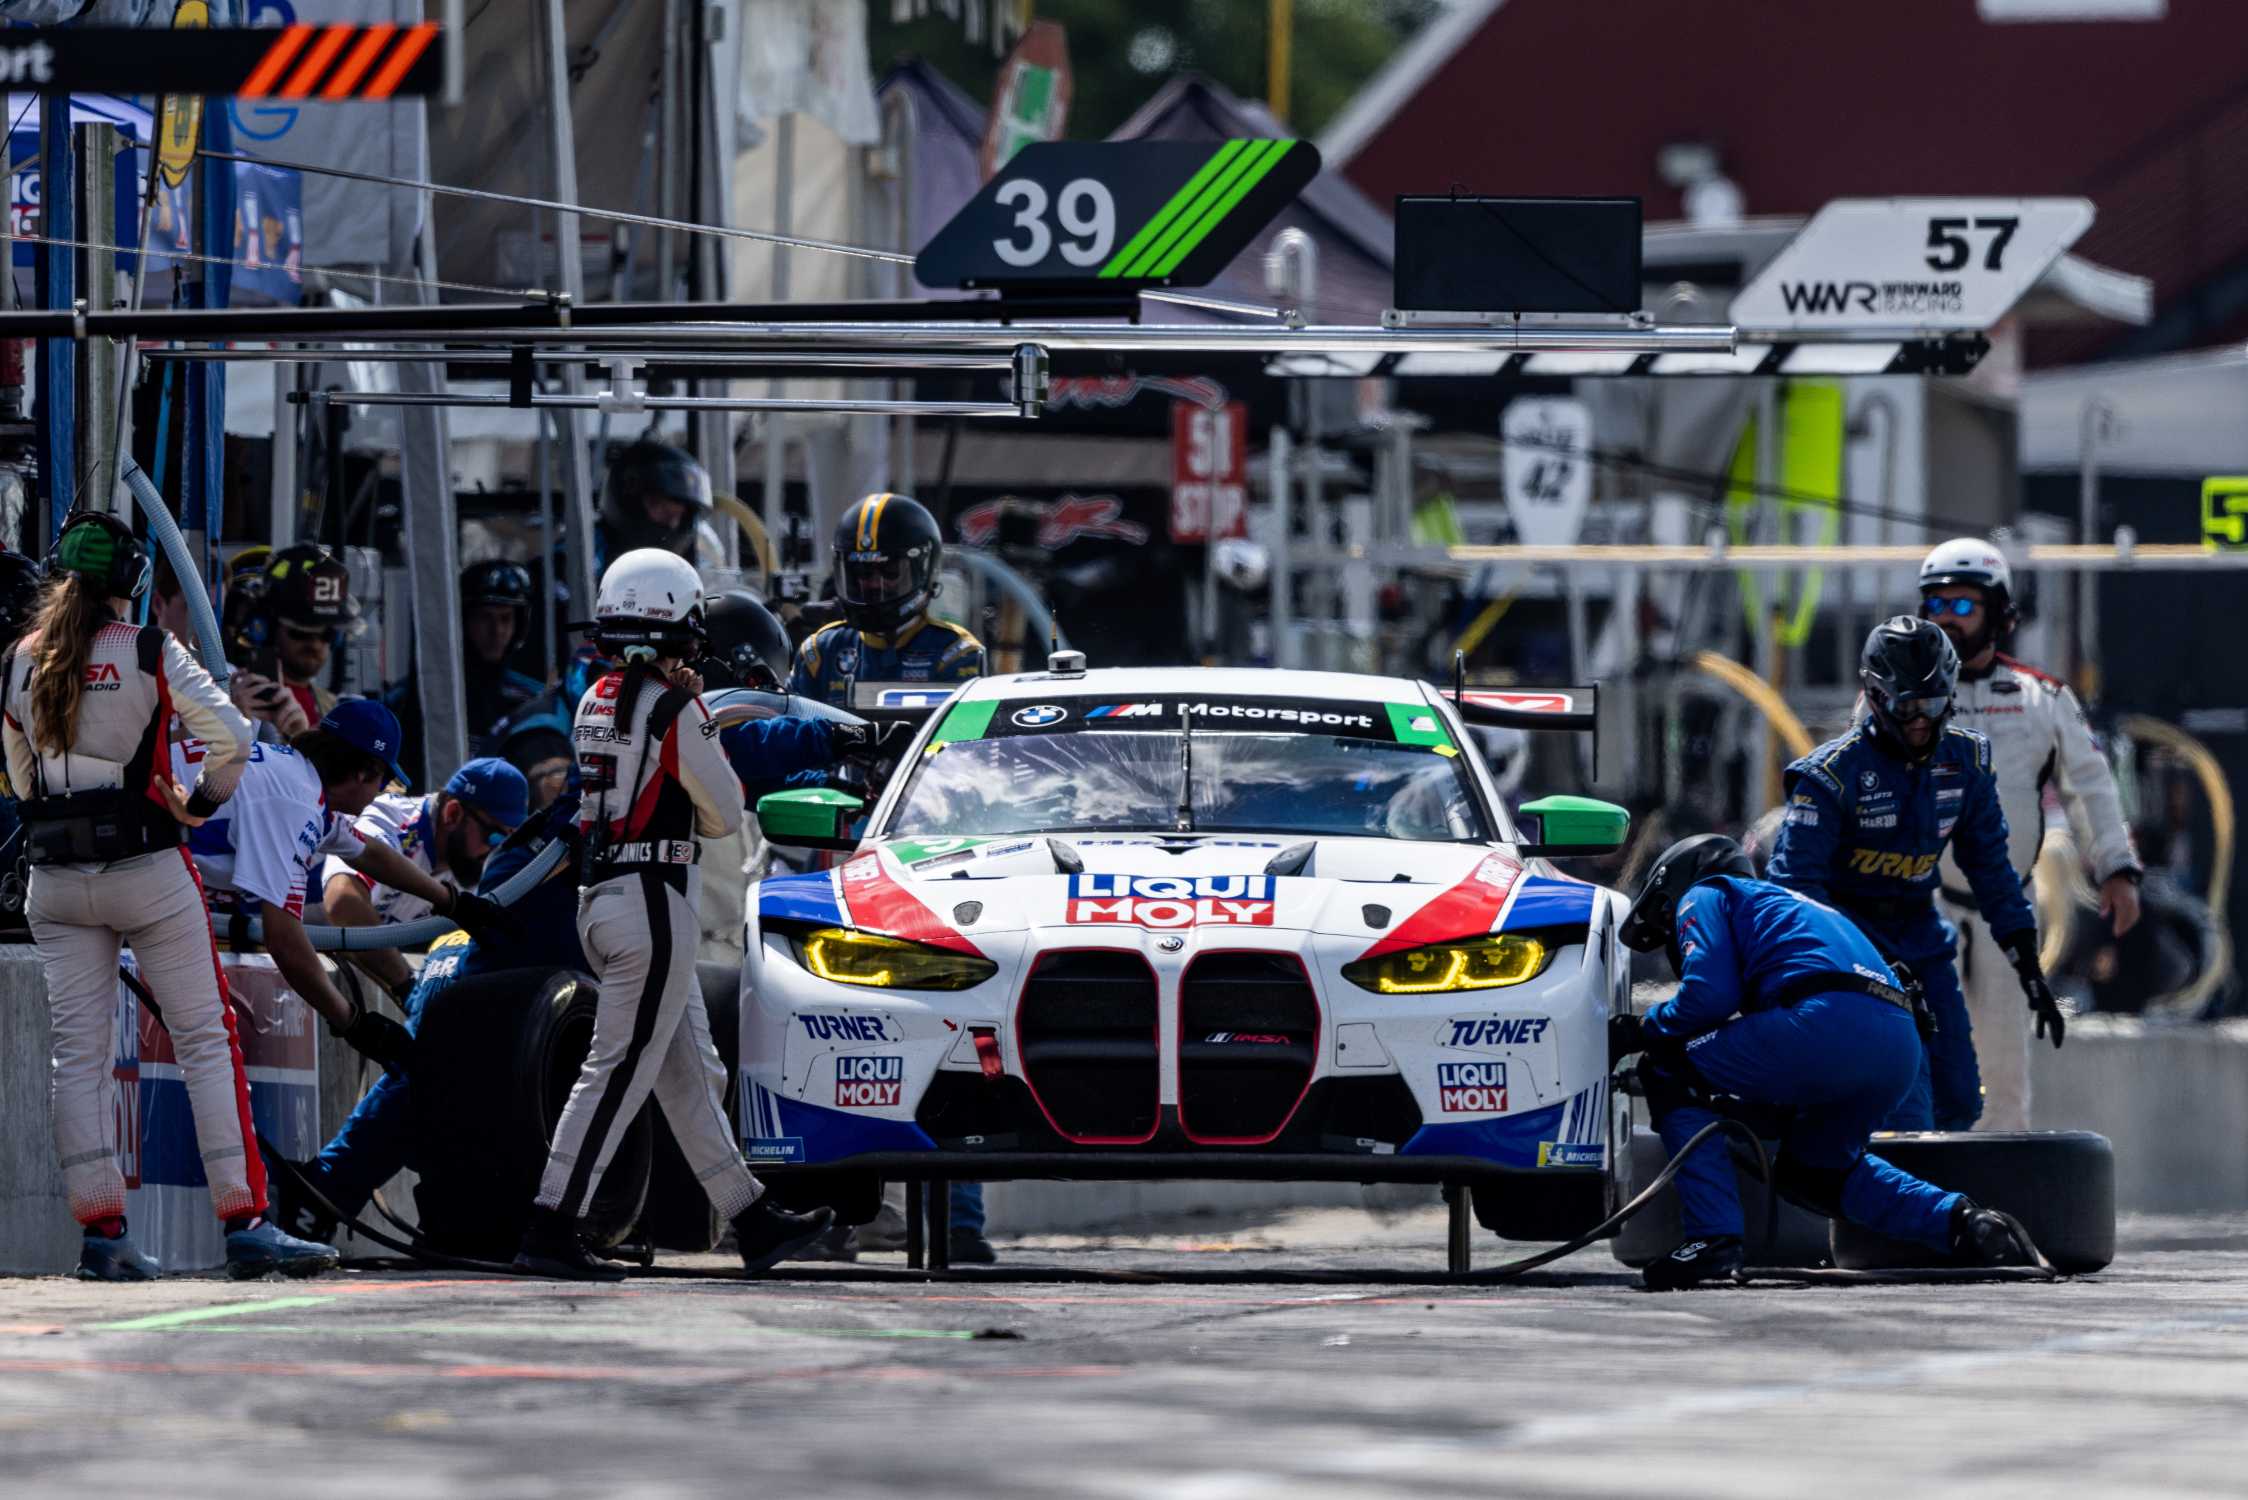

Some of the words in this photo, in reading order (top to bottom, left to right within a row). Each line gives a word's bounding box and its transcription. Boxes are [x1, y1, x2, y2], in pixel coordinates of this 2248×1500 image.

[993, 178, 1116, 267] 39
[1925, 217, 2019, 272] 57
[1882, 281, 1962, 296] WINWARD
[1883, 298, 1962, 313] RACING
[315, 576, 340, 601] 21
[83, 664, 121, 682] SA
[81, 683, 121, 692] ADIO
[592, 704, 616, 717] IMS
[1177, 703, 1372, 728] Motorsport
[373, 739, 387, 751] 95
[1848, 847, 1938, 879] TURNE
[1078, 874, 1267, 899] LIQUI
[1076, 899, 1272, 927] MOLY
[798, 1014, 889, 1041] TURNER
[1233, 1033, 1291, 1045] IMSA
[1450, 1018, 1549, 1046] TURNER
[839, 1058, 900, 1081] LIQUI
[1441, 1064, 1504, 1087] LIQUI
[838, 1082, 900, 1105] MOLY
[1443, 1088, 1506, 1111] MOLY
[112, 1079, 139, 1177] OLY
[751, 1145, 795, 1155] MICHELIN
[1566, 1151, 1602, 1161] MICHEL
